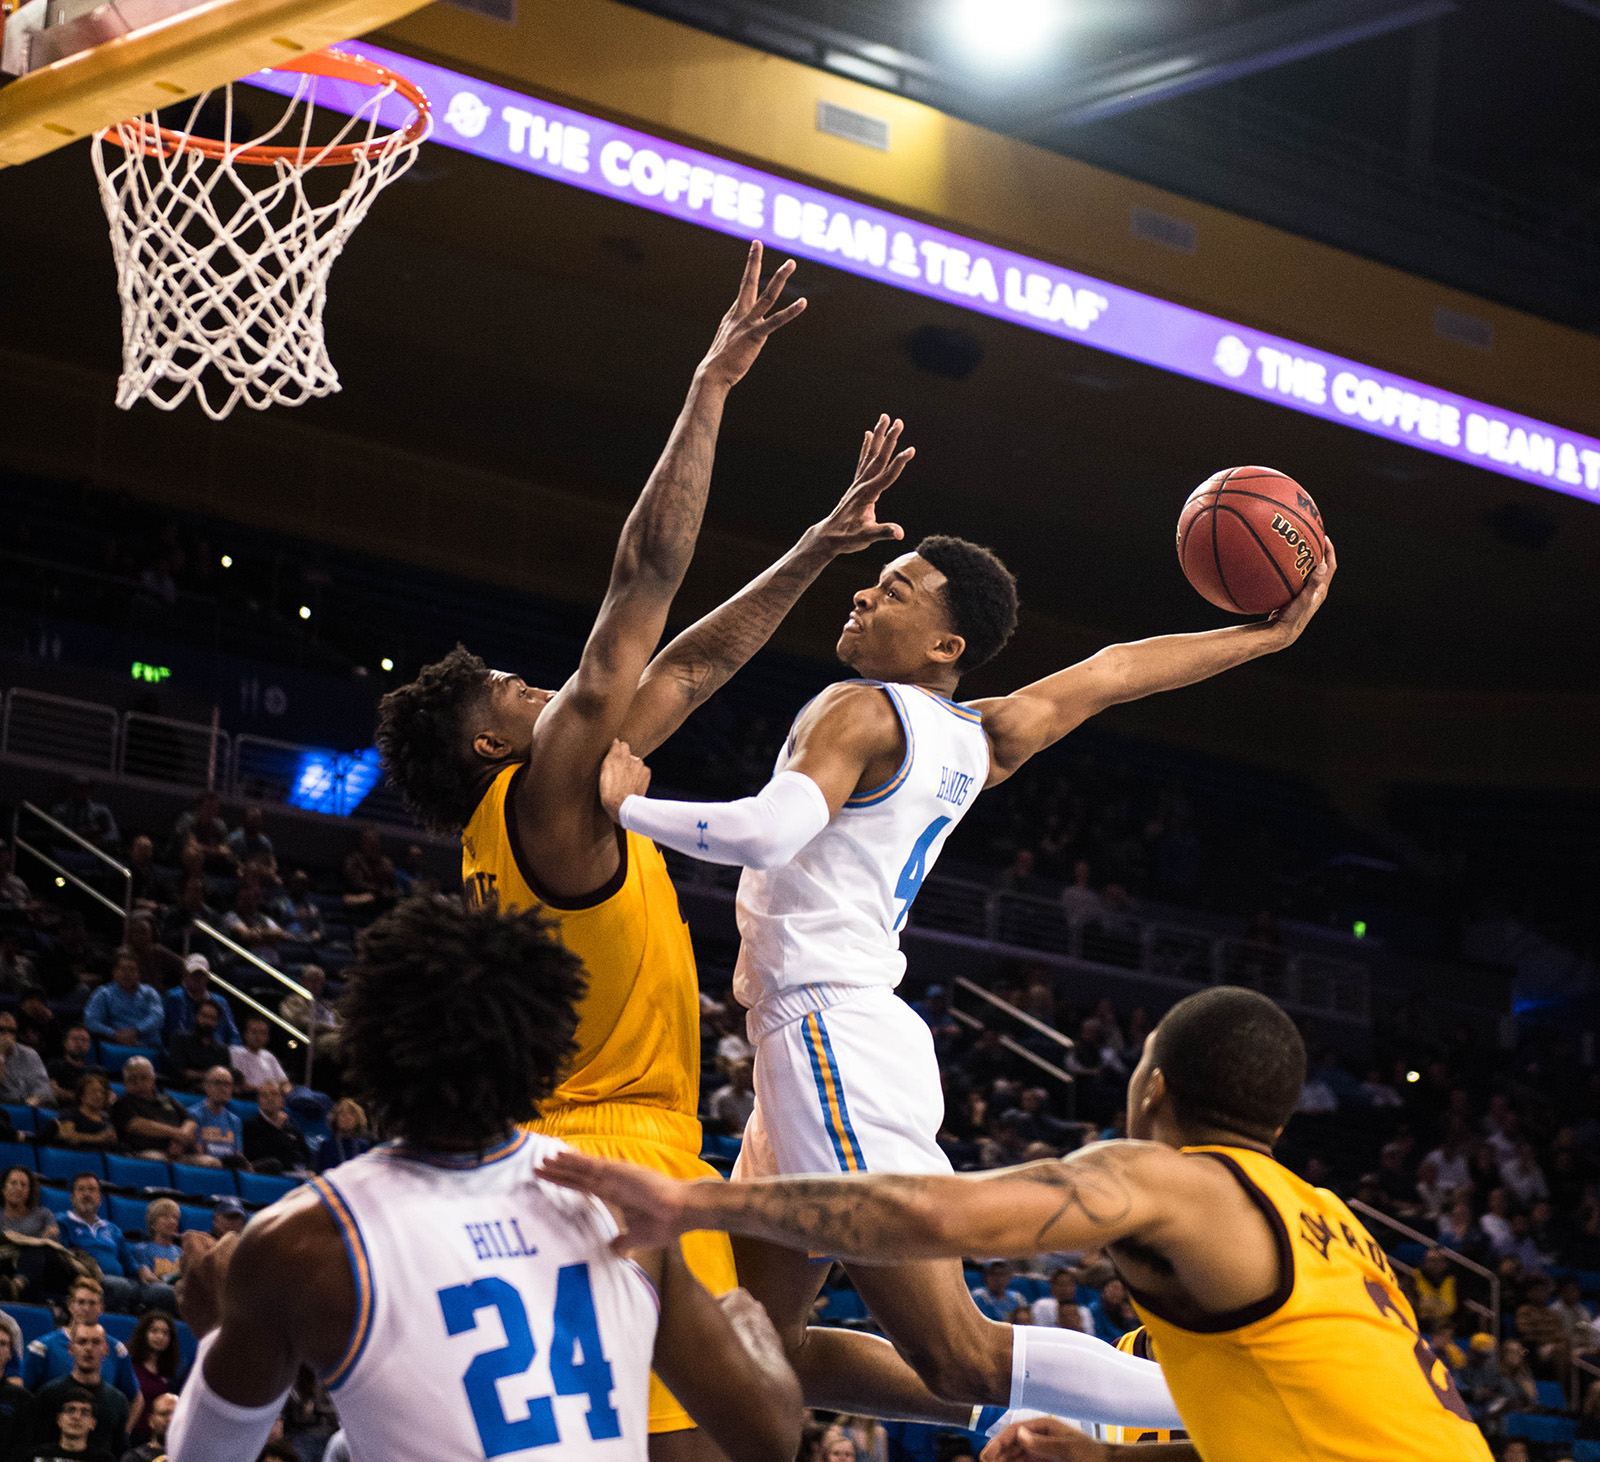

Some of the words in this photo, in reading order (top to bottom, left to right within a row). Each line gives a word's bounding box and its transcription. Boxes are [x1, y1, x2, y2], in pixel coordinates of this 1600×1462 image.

[502, 106, 590, 173] THE
[600, 140, 764, 228] COFFEE
[773, 193, 887, 267] BEAN
[920, 240, 999, 302] TEA
[1257, 346, 1327, 404] THE
[1331, 372, 1461, 447] COFFEE
[1465, 413, 1555, 476] BEAN
[1271, 512, 1315, 582] ilson
[893, 815, 952, 931] 4
[465, 1216, 540, 1260] HILL
[437, 1262, 624, 1459] 24
